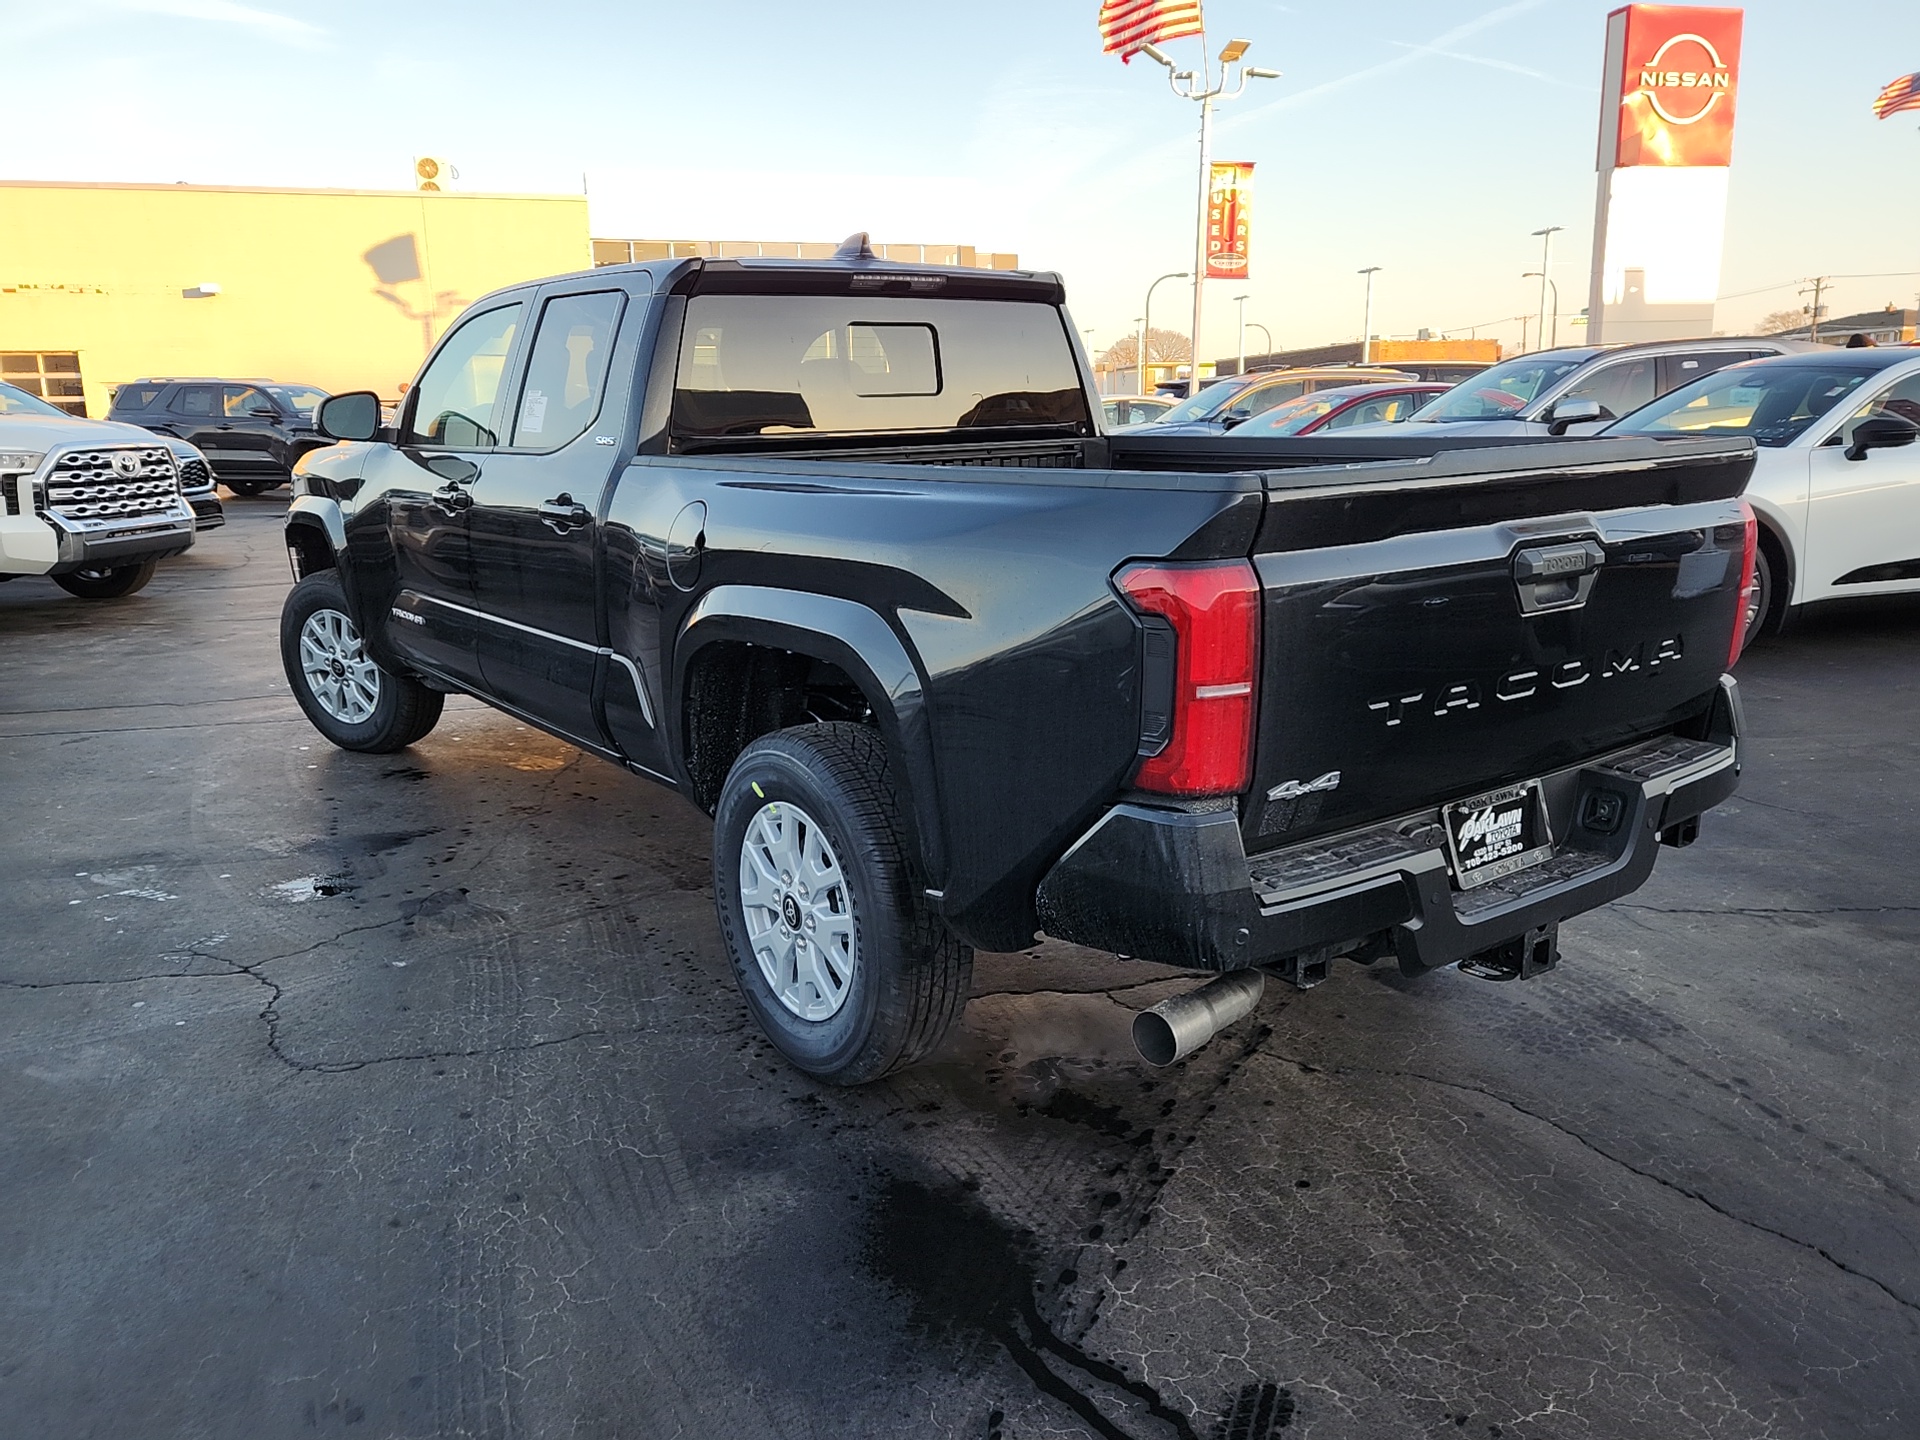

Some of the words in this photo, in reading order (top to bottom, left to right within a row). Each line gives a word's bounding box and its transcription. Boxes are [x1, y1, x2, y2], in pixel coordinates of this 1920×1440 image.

[1640, 71, 1729, 87] NISSAN
[1210, 192, 1223, 250] USED
[1236, 192, 1248, 251] CARS
[1544, 553, 1585, 572] TOYOTA
[1367, 633, 1685, 726] TACOMA
[1469, 796, 1487, 808] OAK
[1490, 789, 1514, 802] LAWN
[1490, 827, 1517, 841] TOYOTA
[1464, 842, 1523, 870] 708-423-5200
[1490, 857, 1524, 875] TOYOTA
